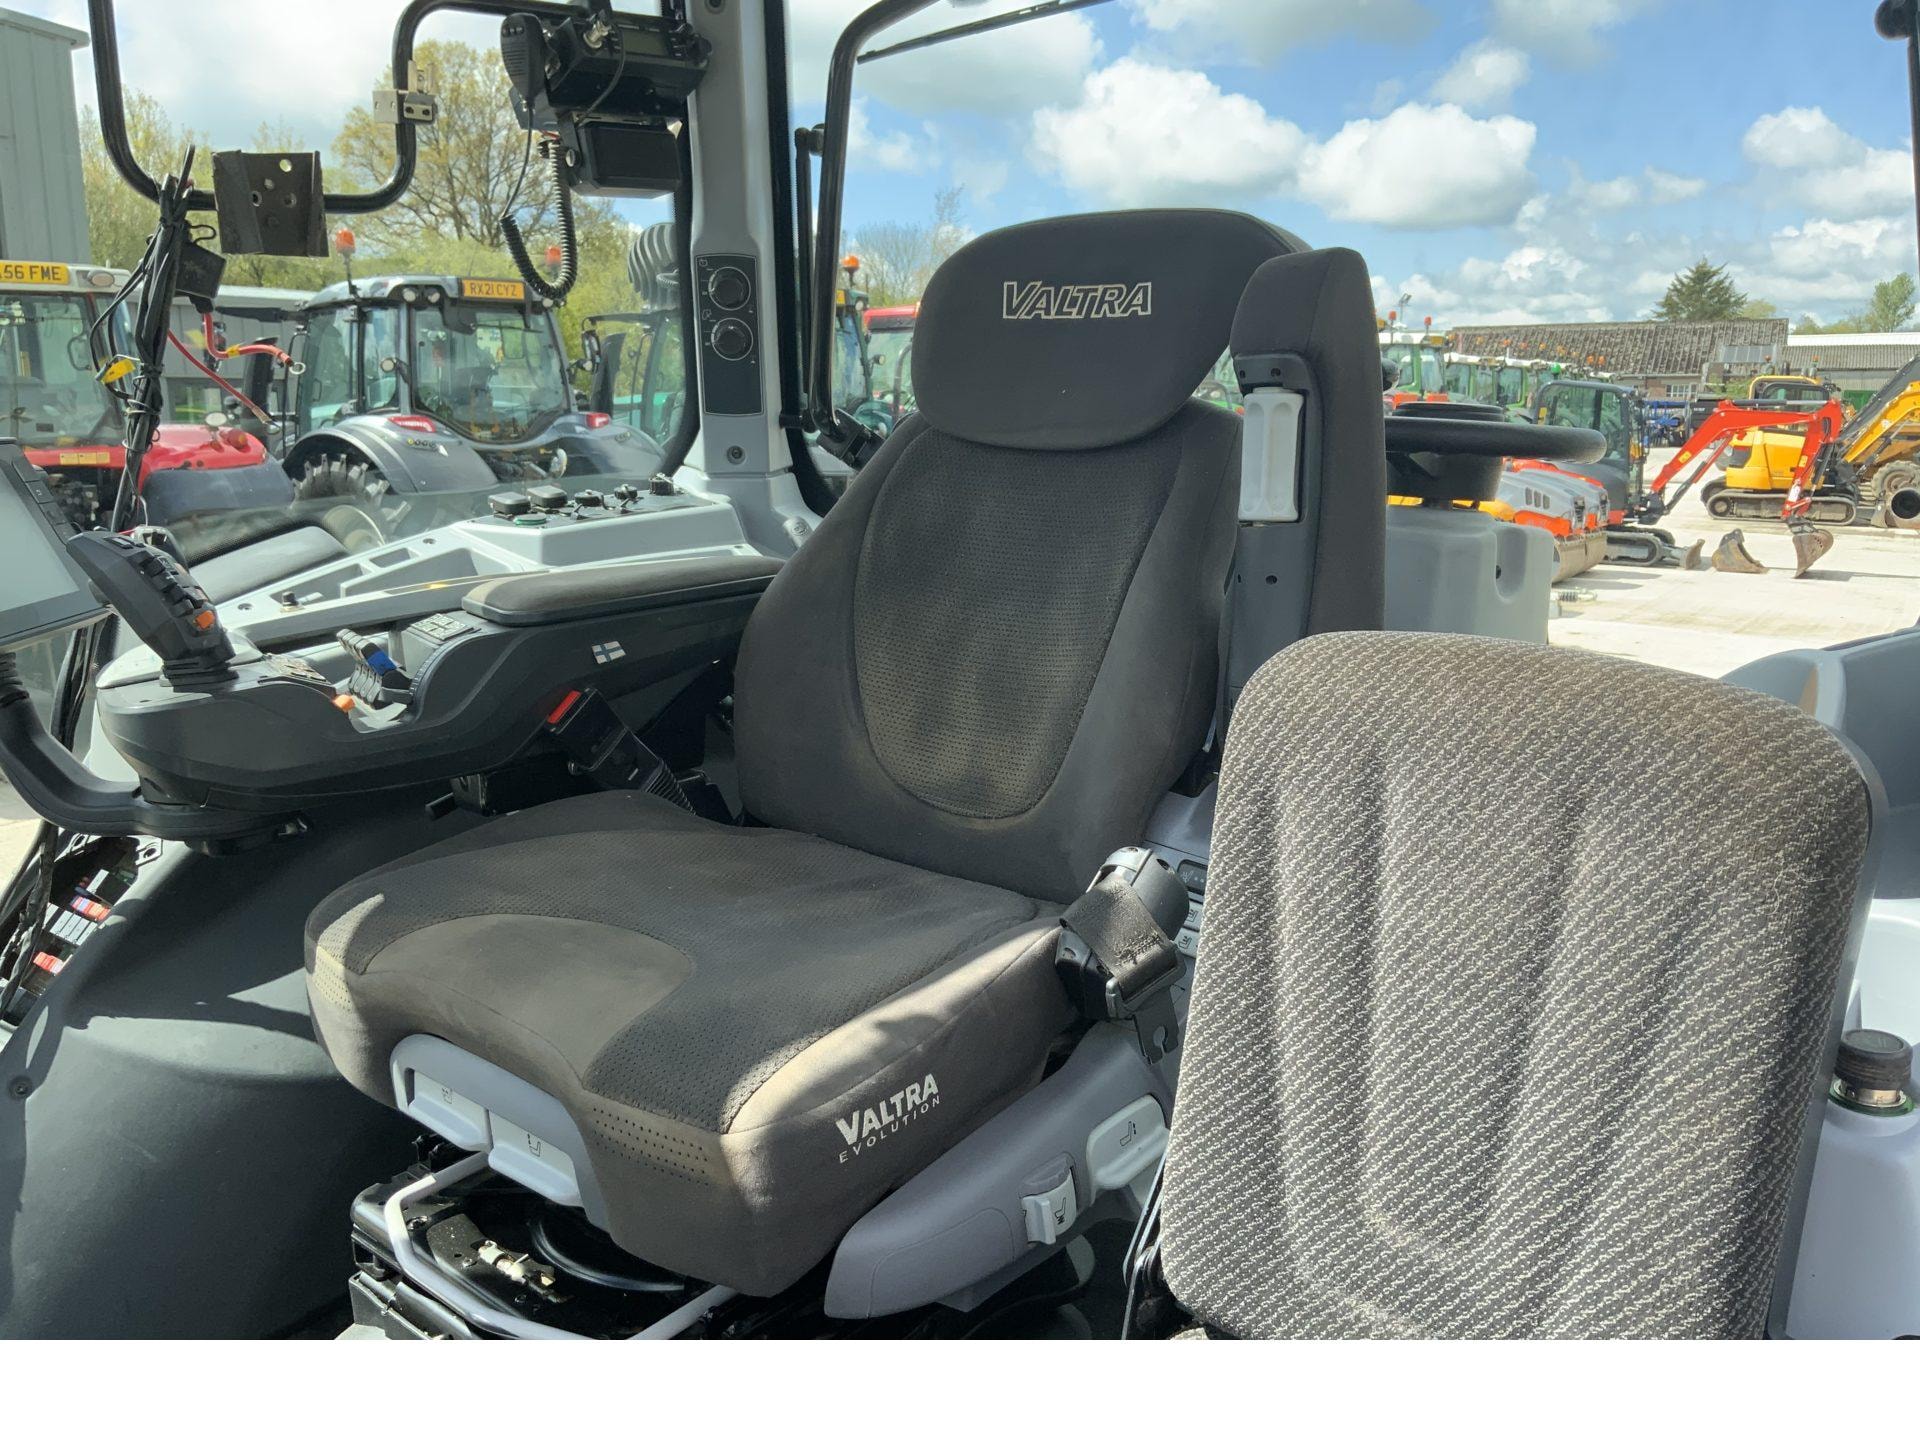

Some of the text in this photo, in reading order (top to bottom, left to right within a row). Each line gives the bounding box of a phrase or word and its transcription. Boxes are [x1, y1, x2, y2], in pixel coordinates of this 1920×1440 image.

[0, 264, 62, 281] 56 FME
[1003, 281, 1152, 319] VALTRA
[835, 1073, 939, 1146] VALTRA
[839, 1095, 940, 1164] EVOLUTION
